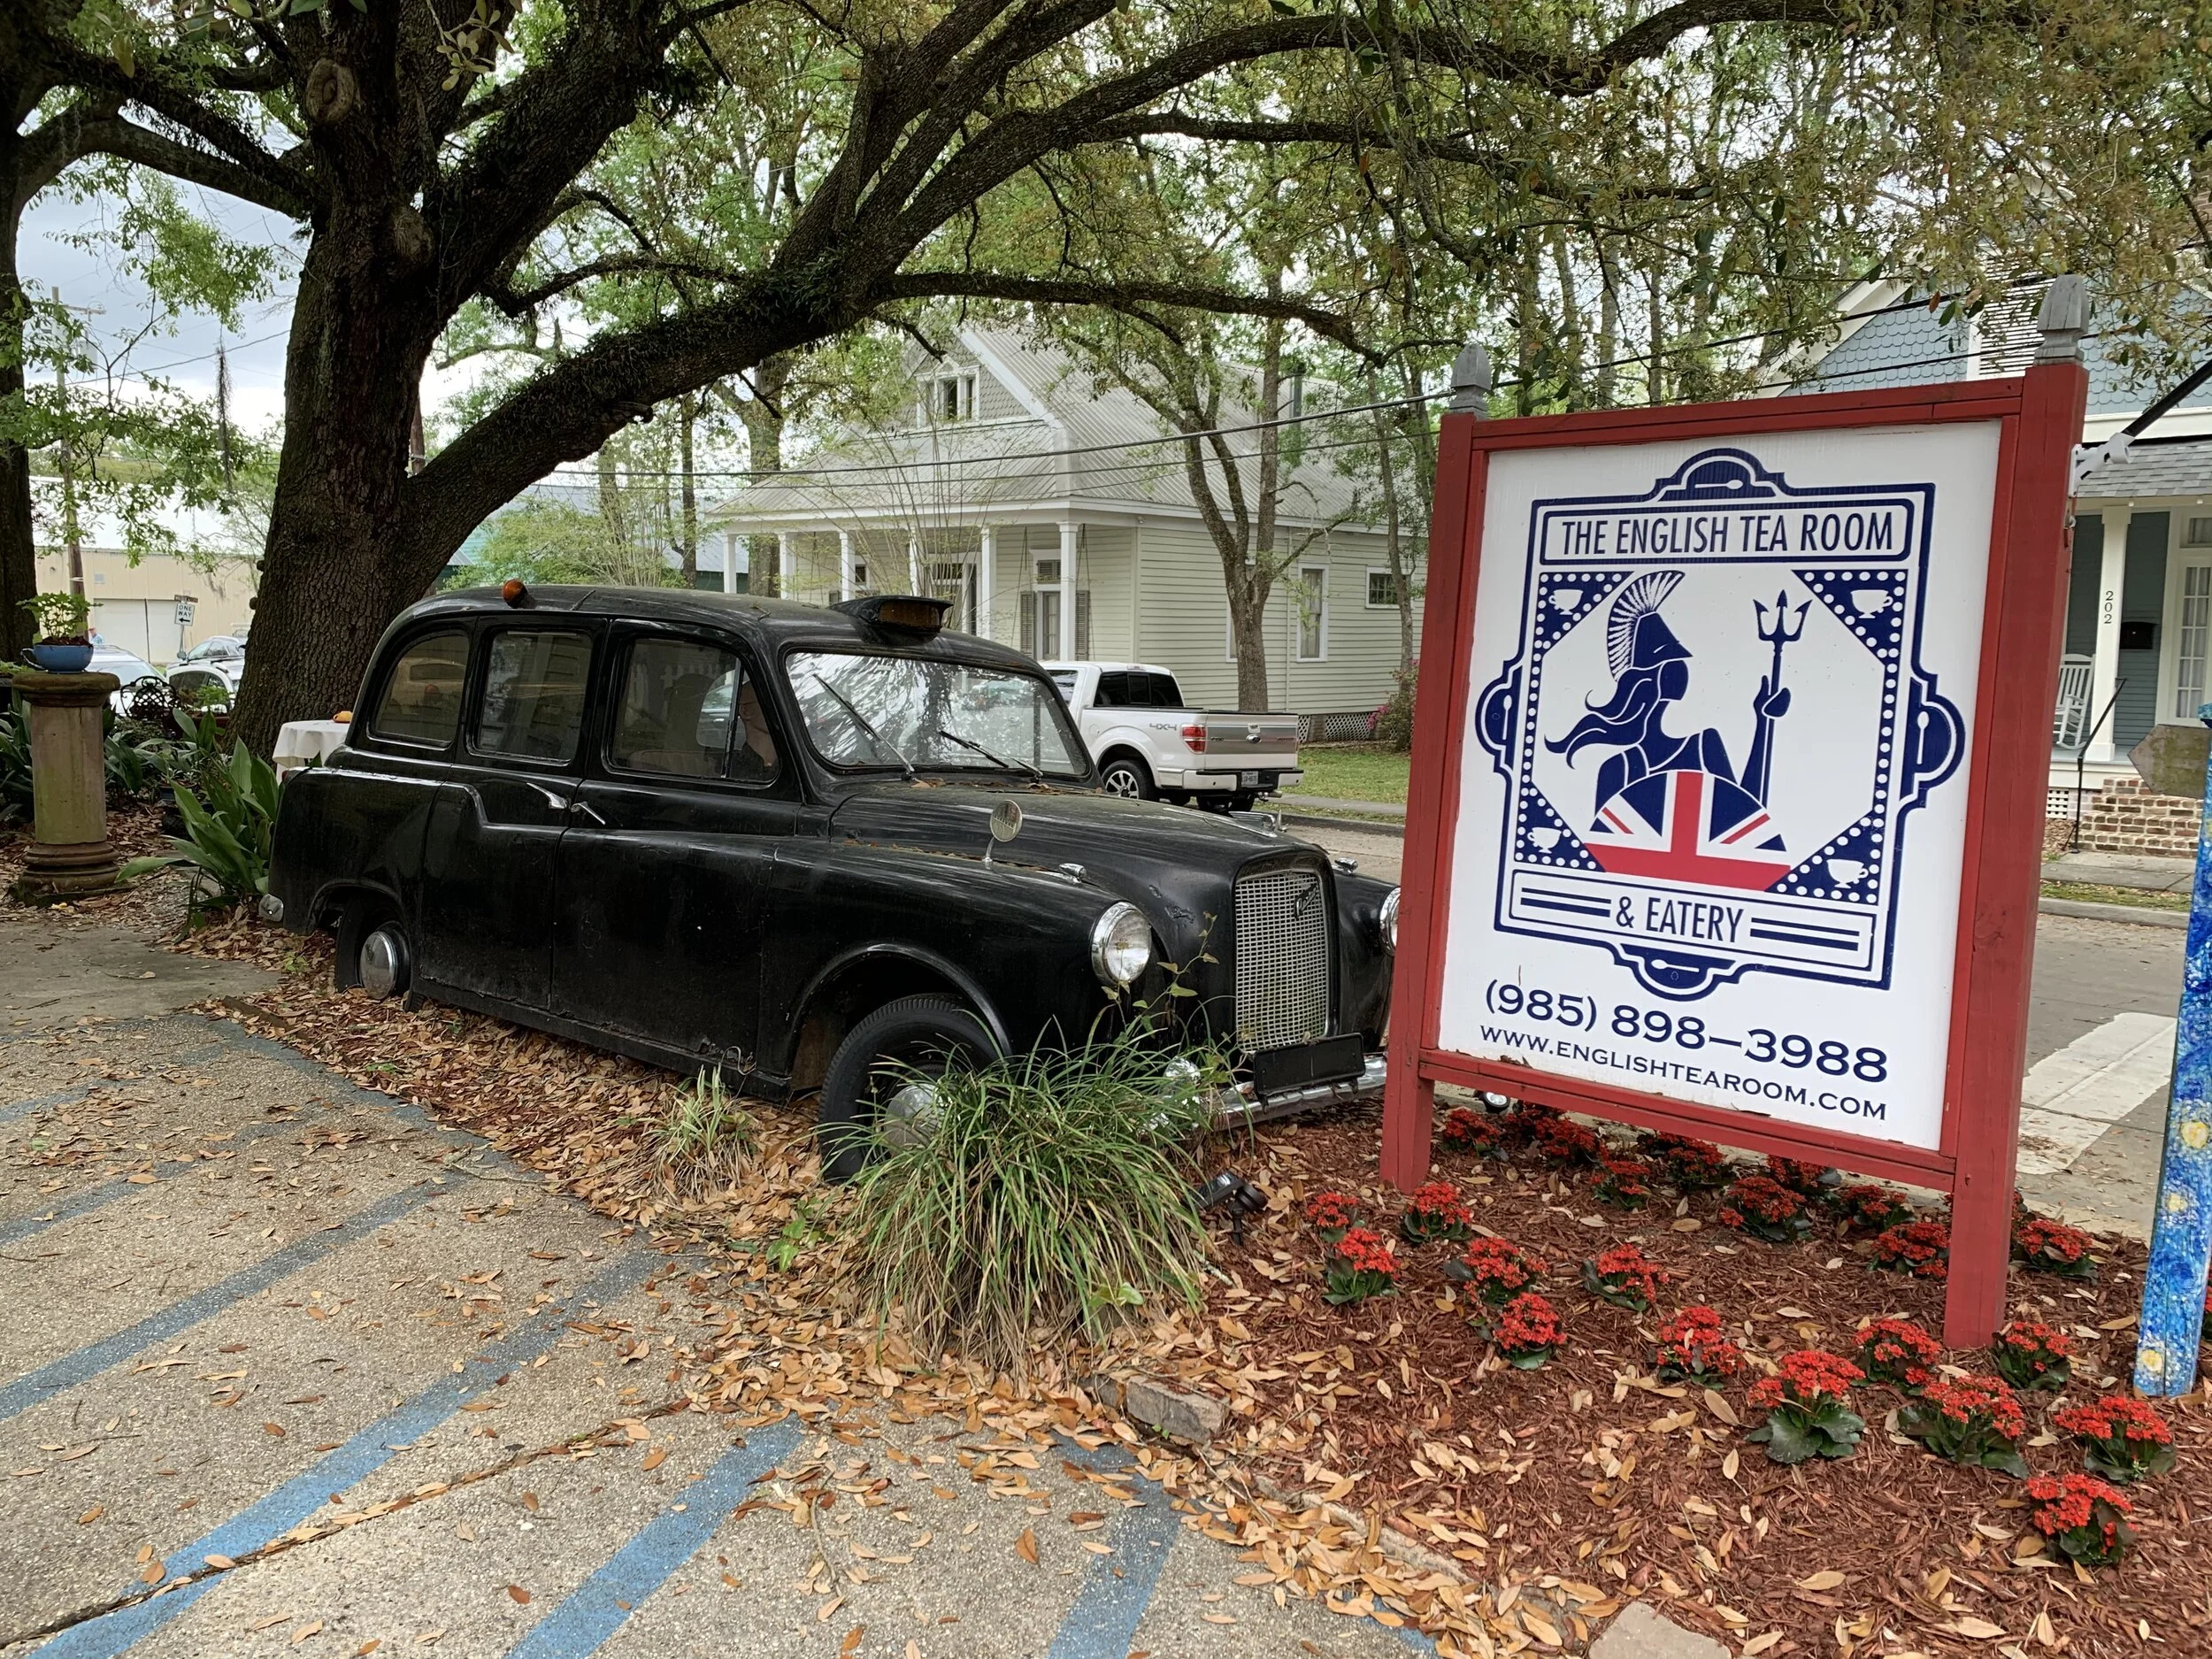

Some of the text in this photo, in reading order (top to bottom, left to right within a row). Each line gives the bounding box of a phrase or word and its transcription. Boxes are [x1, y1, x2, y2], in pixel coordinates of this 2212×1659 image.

[1562, 511, 1893, 556] THE ENGLISH TEA ROOM
[2103, 590, 2114, 625] 202
[1615, 895, 1745, 943] & EATERY
[1486, 979, 1598, 1033] (985)
[1479, 1025, 1887, 1121] WWW.ENGLISHTEAROOM.COM
